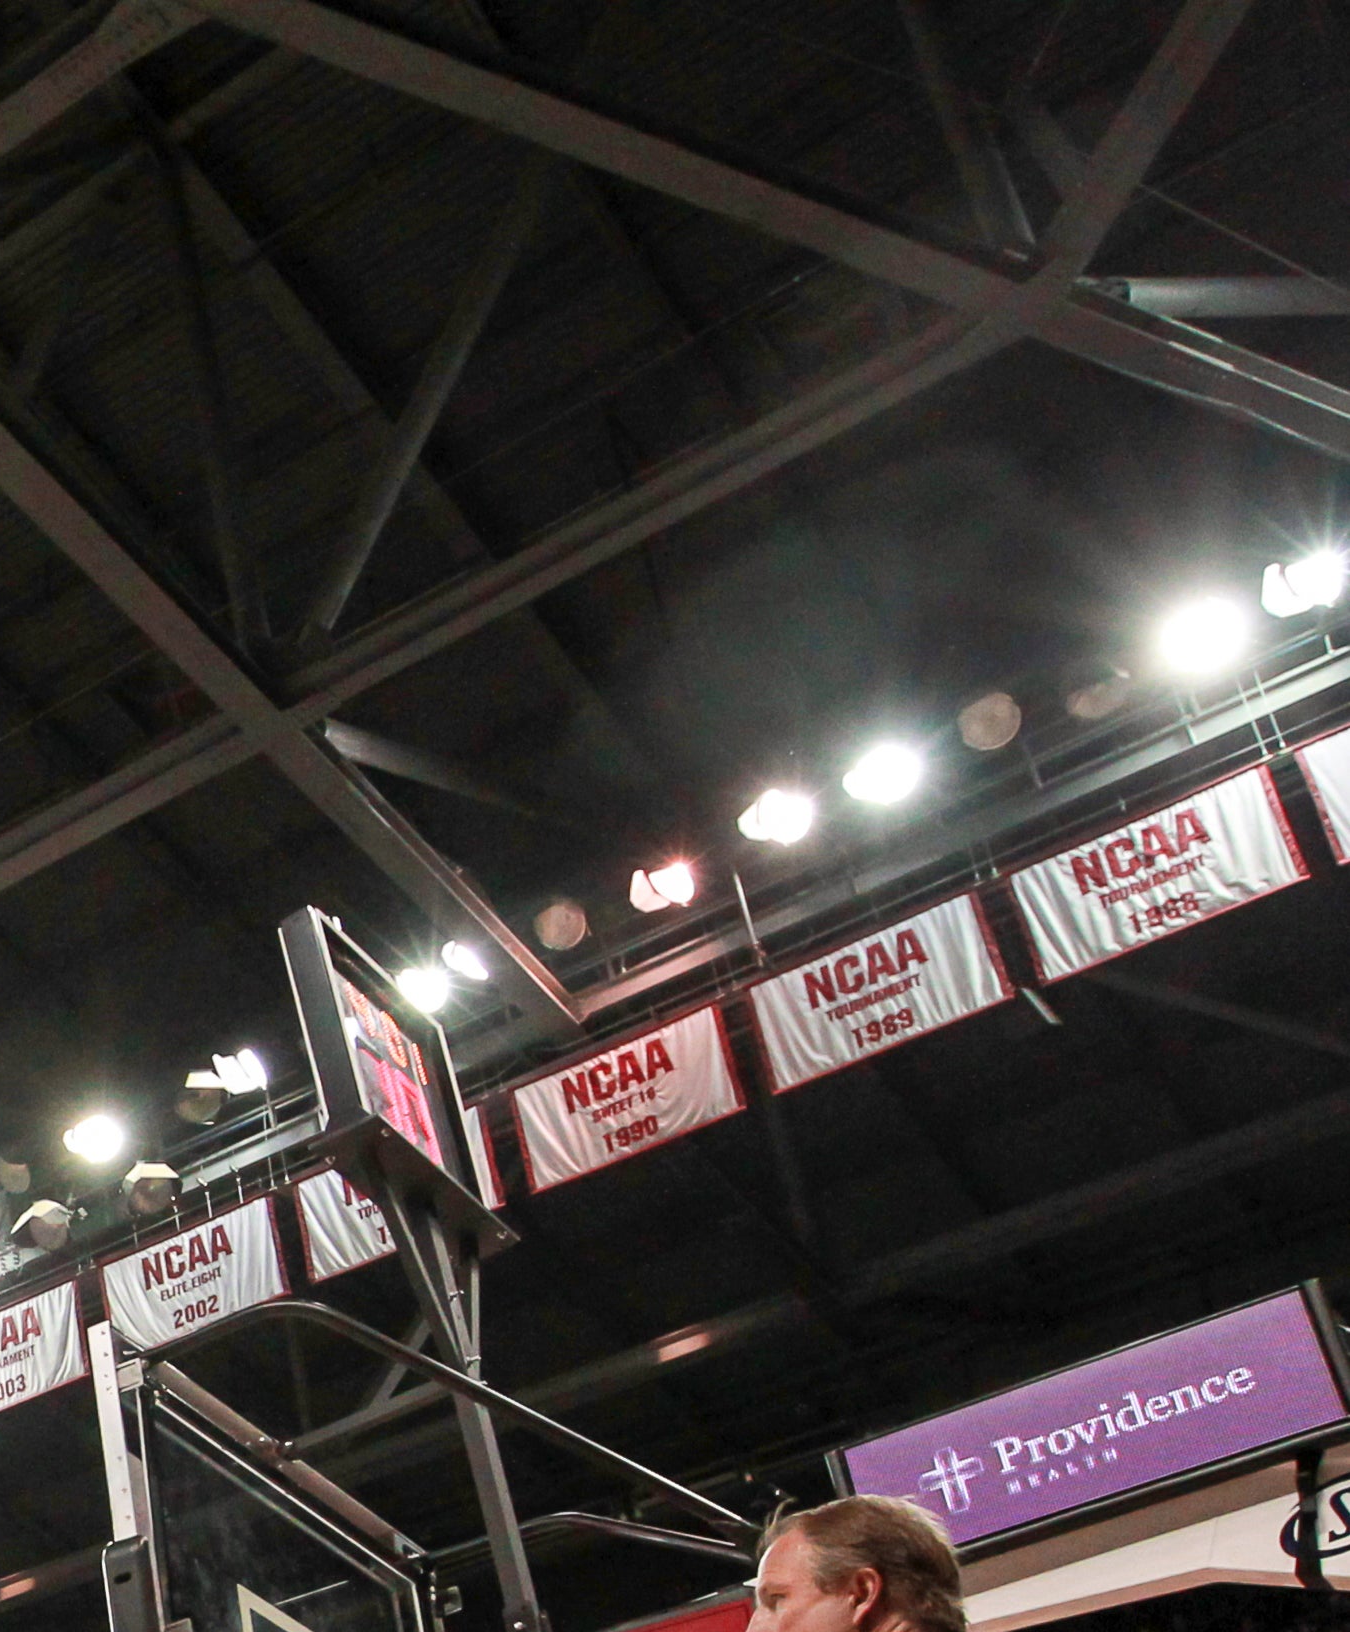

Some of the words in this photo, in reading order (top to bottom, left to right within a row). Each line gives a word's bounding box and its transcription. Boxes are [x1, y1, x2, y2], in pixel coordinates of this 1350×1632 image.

[1070, 808, 1211, 896] NCAA
[803, 928, 929, 1010] NCAA
[851, 1008, 915, 1049] 1989
[561, 1038, 675, 1115] NCAA
[602, 1114, 660, 1154] 1990
[141, 1223, 233, 1291] NCAA
[160, 1278, 191, 1302] ELITE
[192, 1266, 222, 1291] EIGHT
[173, 1294, 220, 1330] 2002
[993, 1362, 1256, 1475] Providence
[1007, 1447, 1118, 1495] HEALTH
